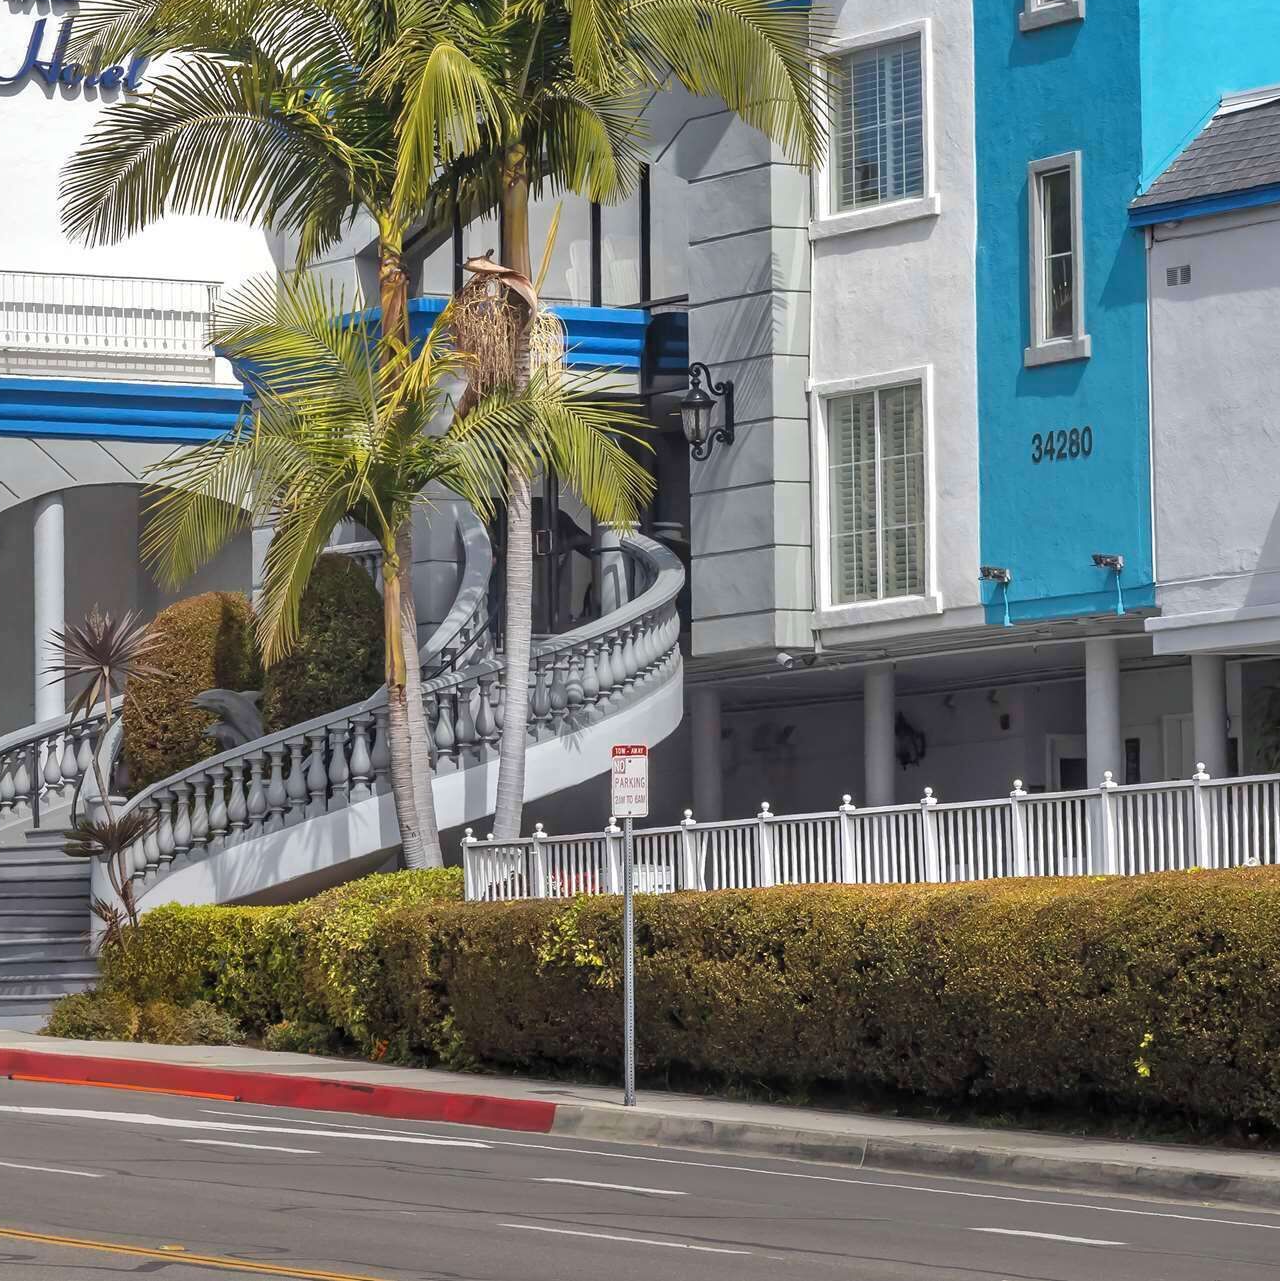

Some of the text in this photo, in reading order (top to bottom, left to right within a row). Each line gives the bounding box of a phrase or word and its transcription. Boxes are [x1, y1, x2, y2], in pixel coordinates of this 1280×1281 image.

[1031, 426, 1093, 464] 34280
[614, 760, 625, 774] NO
[615, 776, 645, 788] PARKING
[626, 795, 634, 804] TO
